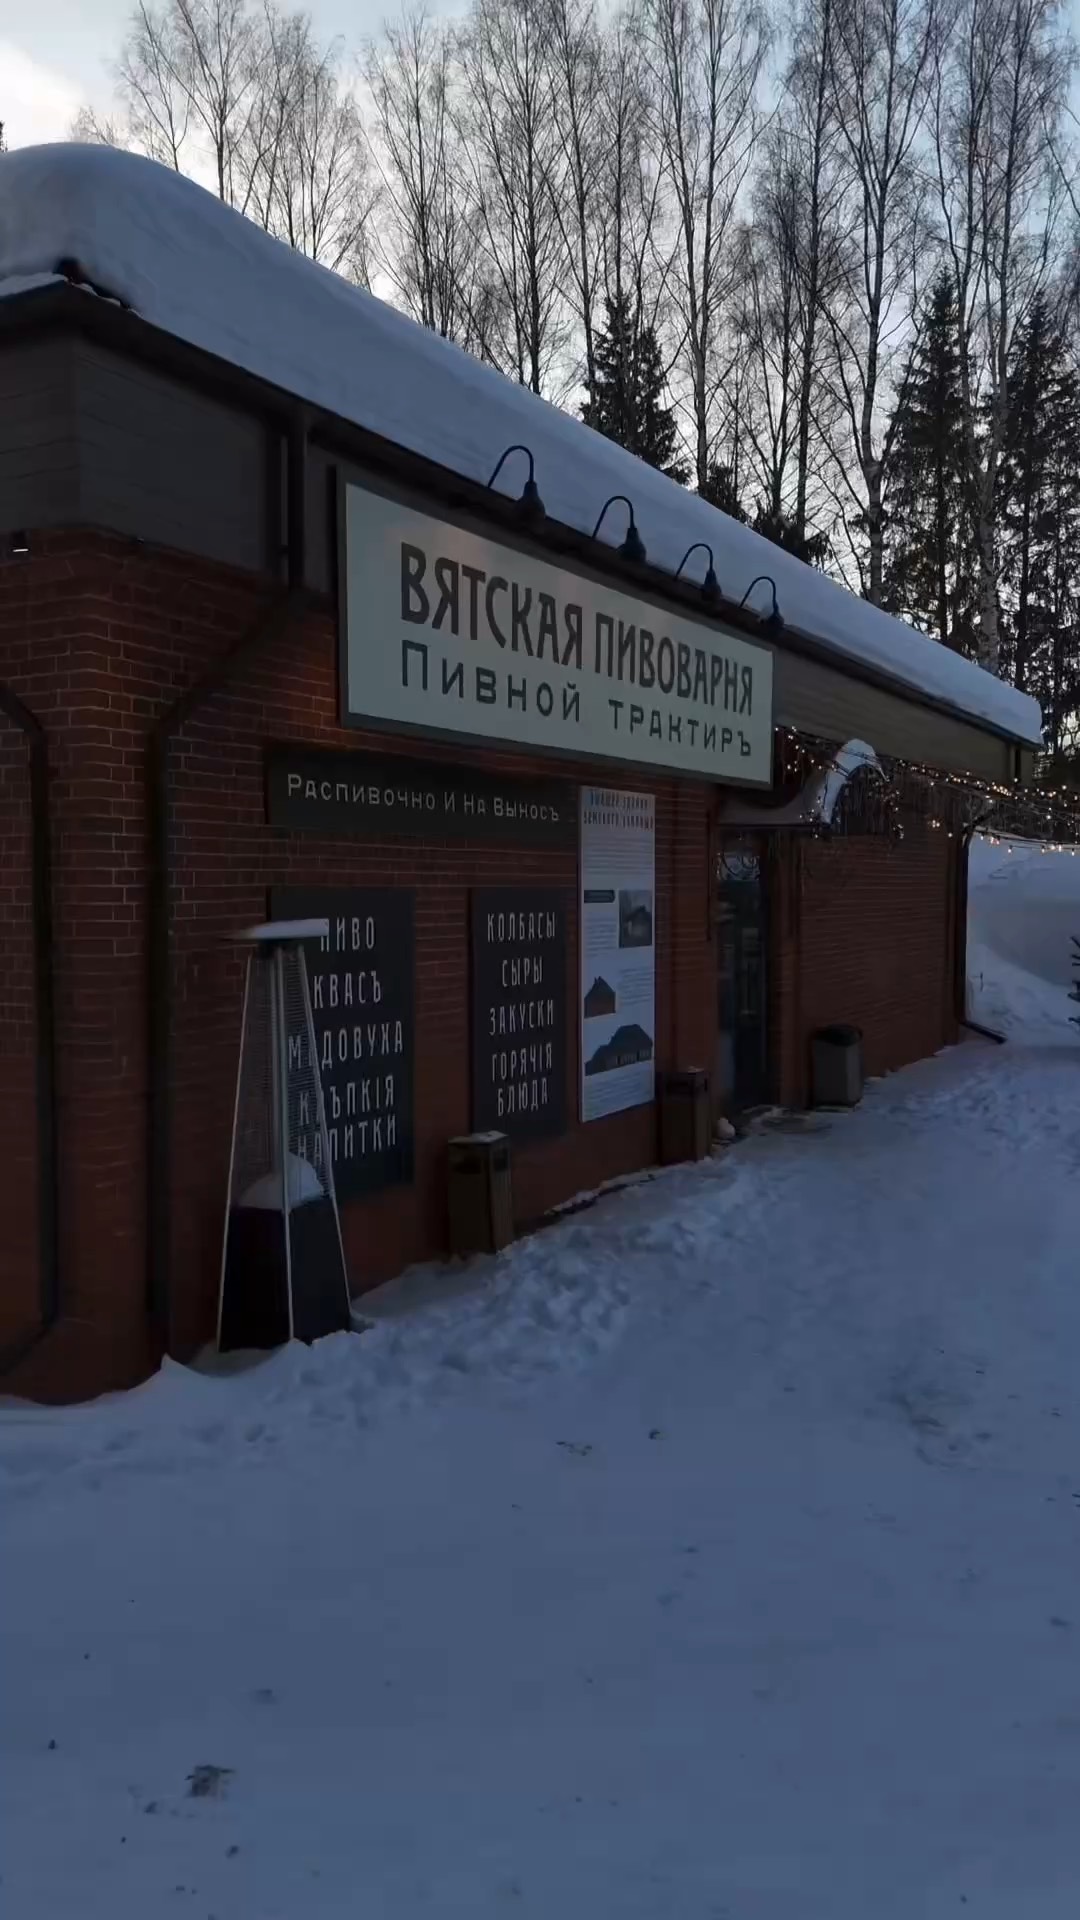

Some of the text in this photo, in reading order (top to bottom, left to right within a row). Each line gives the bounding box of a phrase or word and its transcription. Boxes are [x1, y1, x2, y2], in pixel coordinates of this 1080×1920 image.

[400, 542, 754, 717] ВЯТСКАЯ ПИВОВАРНЯ
[402, 640, 752, 757] ПИВНОЙ ТРАКТИРЪ
[443, 790, 456, 813] И
[487, 911, 556, 943] КОЛБАСЫ
[313, 970, 382, 1010] КВАСЪ
[502, 956, 544, 988] СЫРЫ
[489, 999, 554, 1036] ЗАКУСКИ
[288, 1020, 404, 1071] МДОВУХА
[300, 1073, 394, 1126] КЪПКІЯ
[497, 1077, 549, 1117] БЛЮДА
